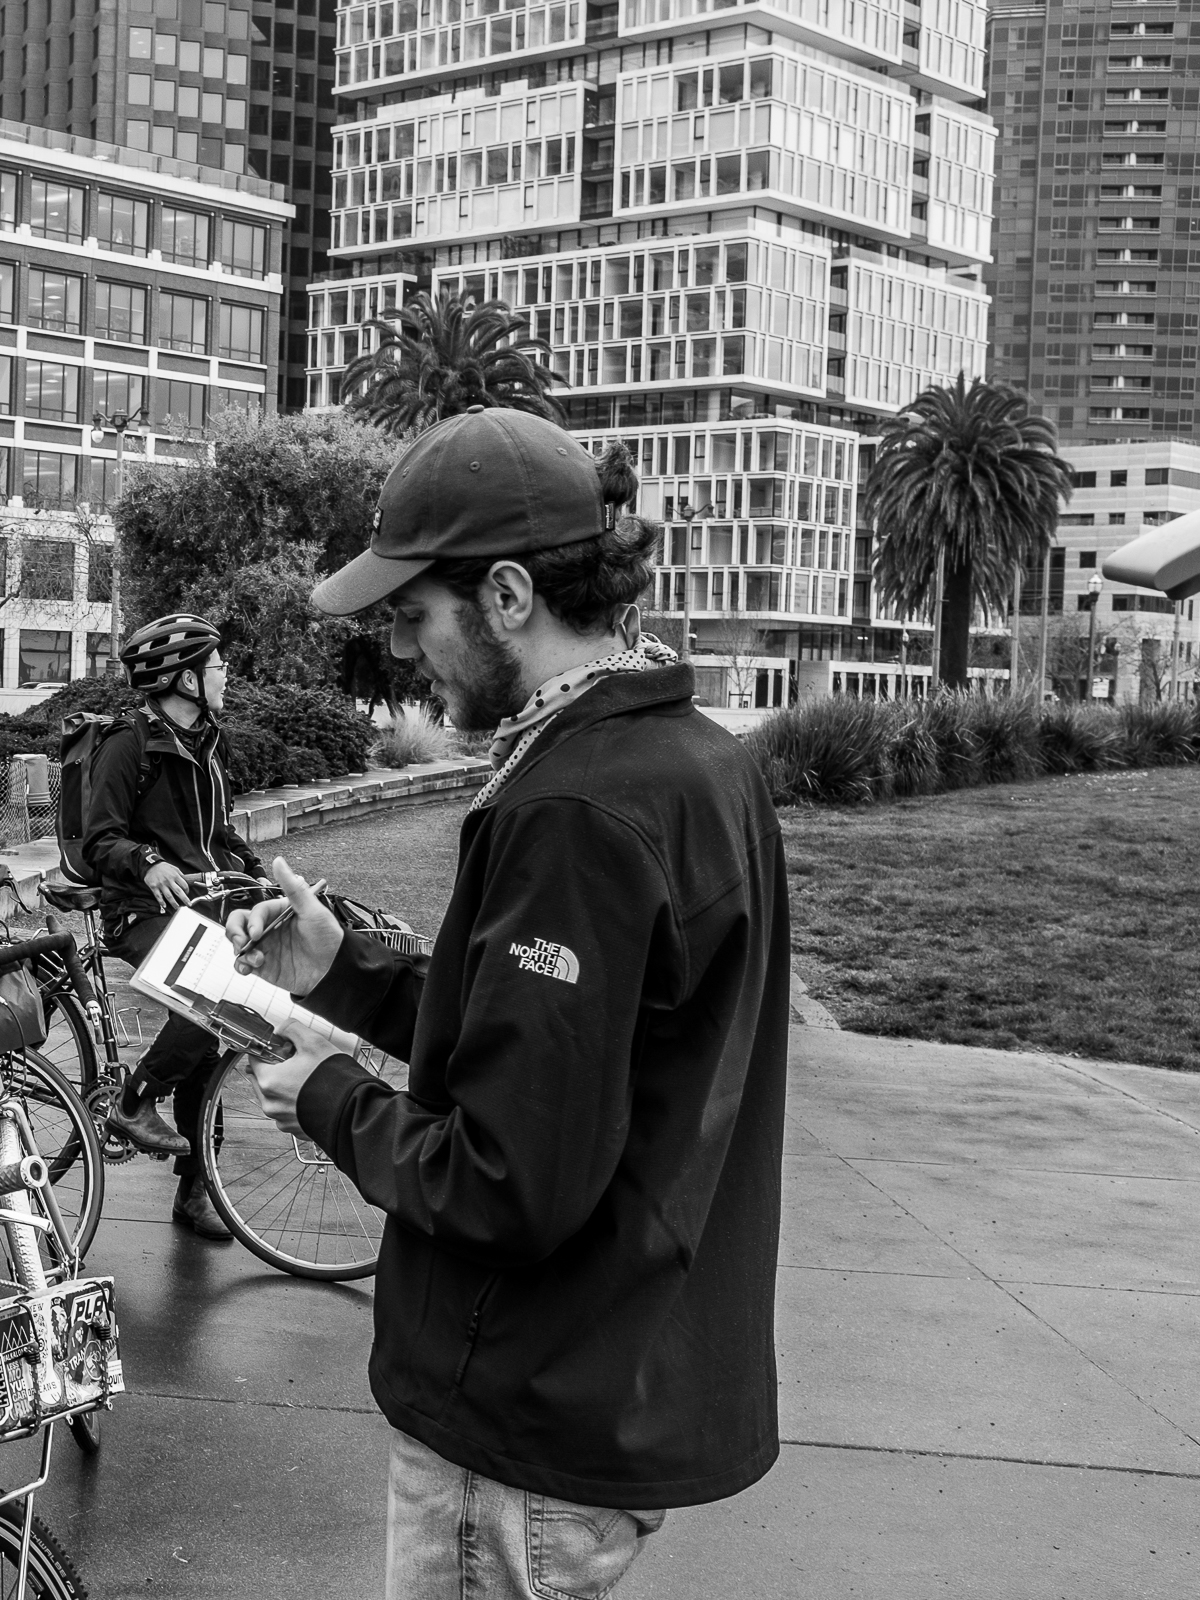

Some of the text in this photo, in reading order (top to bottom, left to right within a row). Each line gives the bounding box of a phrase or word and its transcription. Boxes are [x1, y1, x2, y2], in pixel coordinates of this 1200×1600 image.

[508, 942, 557, 966] NORTH
[534, 937, 561, 956] THE
[518, 957, 555, 977] FACE
[29, 1529, 67, 1578] CHWALBE
